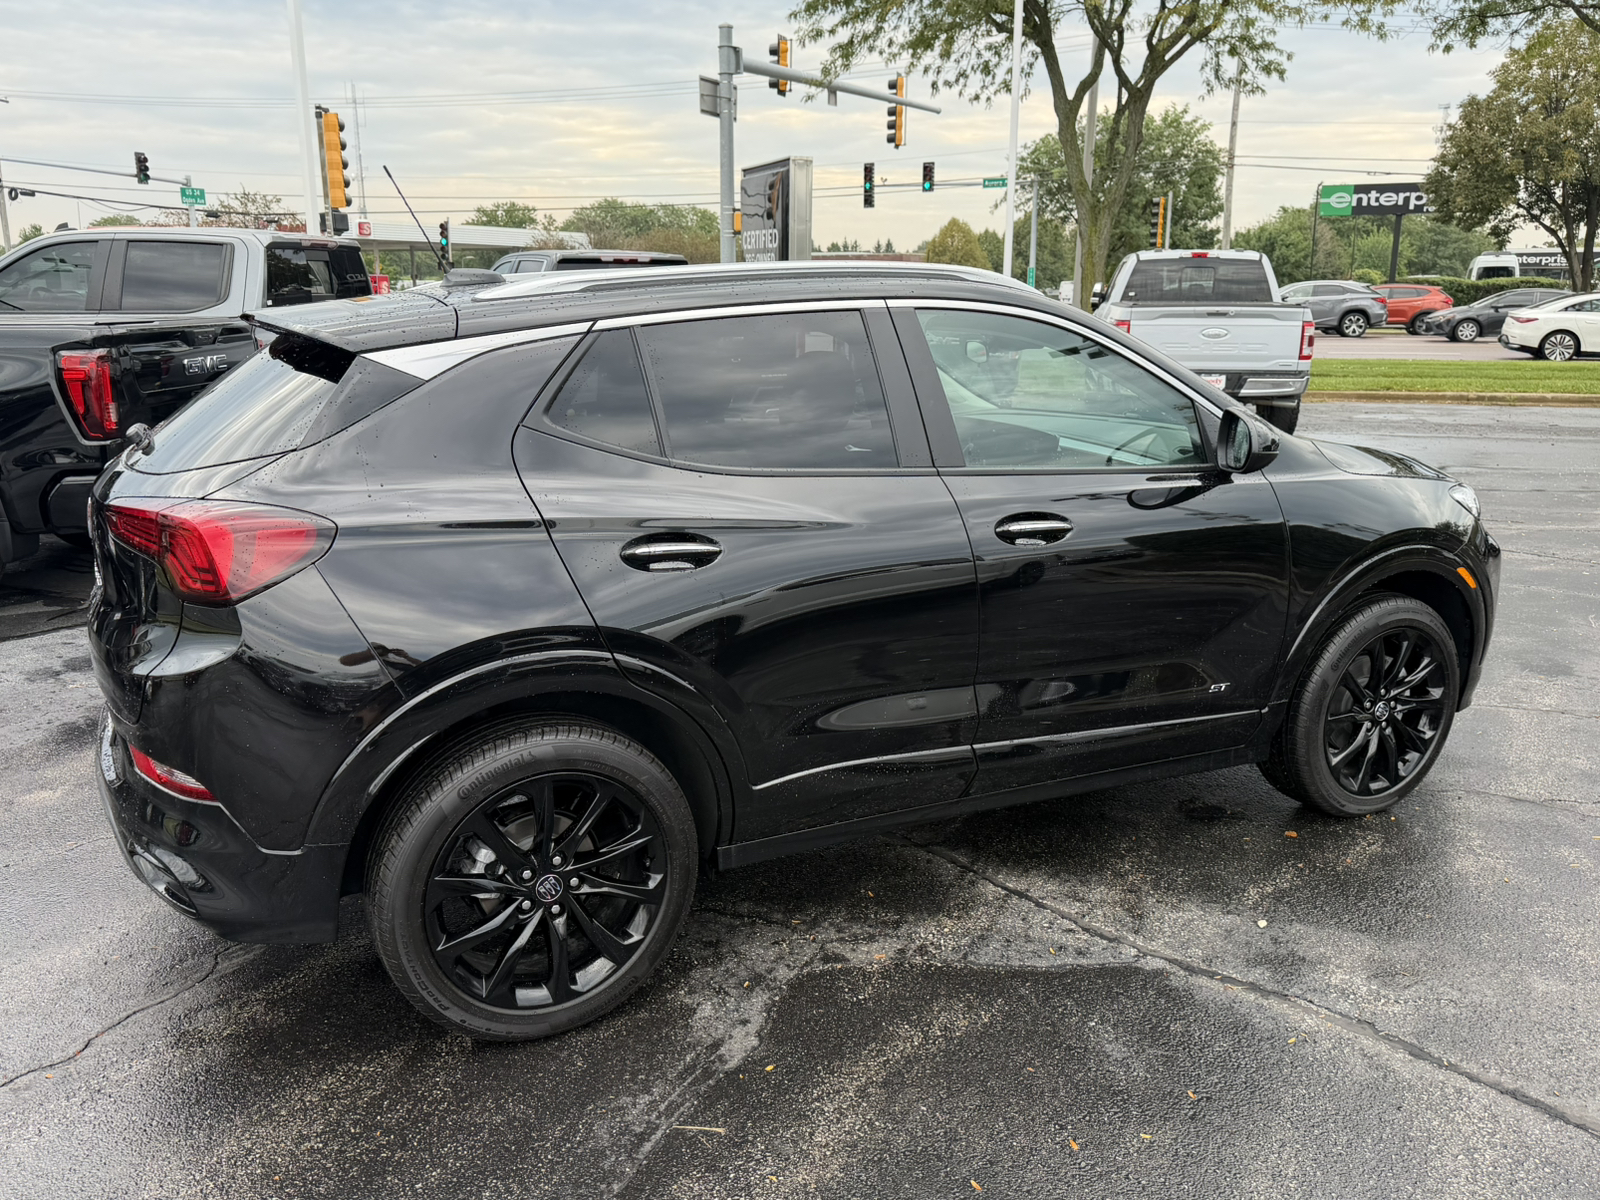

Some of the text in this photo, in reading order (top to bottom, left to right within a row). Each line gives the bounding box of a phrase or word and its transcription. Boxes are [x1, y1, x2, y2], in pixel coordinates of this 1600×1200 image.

[1328, 190, 1428, 210] enterp
[742, 229, 779, 249] CERTIFIED
[1517, 254, 1569, 266] nterpris
[182, 354, 228, 376] GMC
[1209, 682, 1231, 693] ST
[457, 753, 526, 800] Continental
